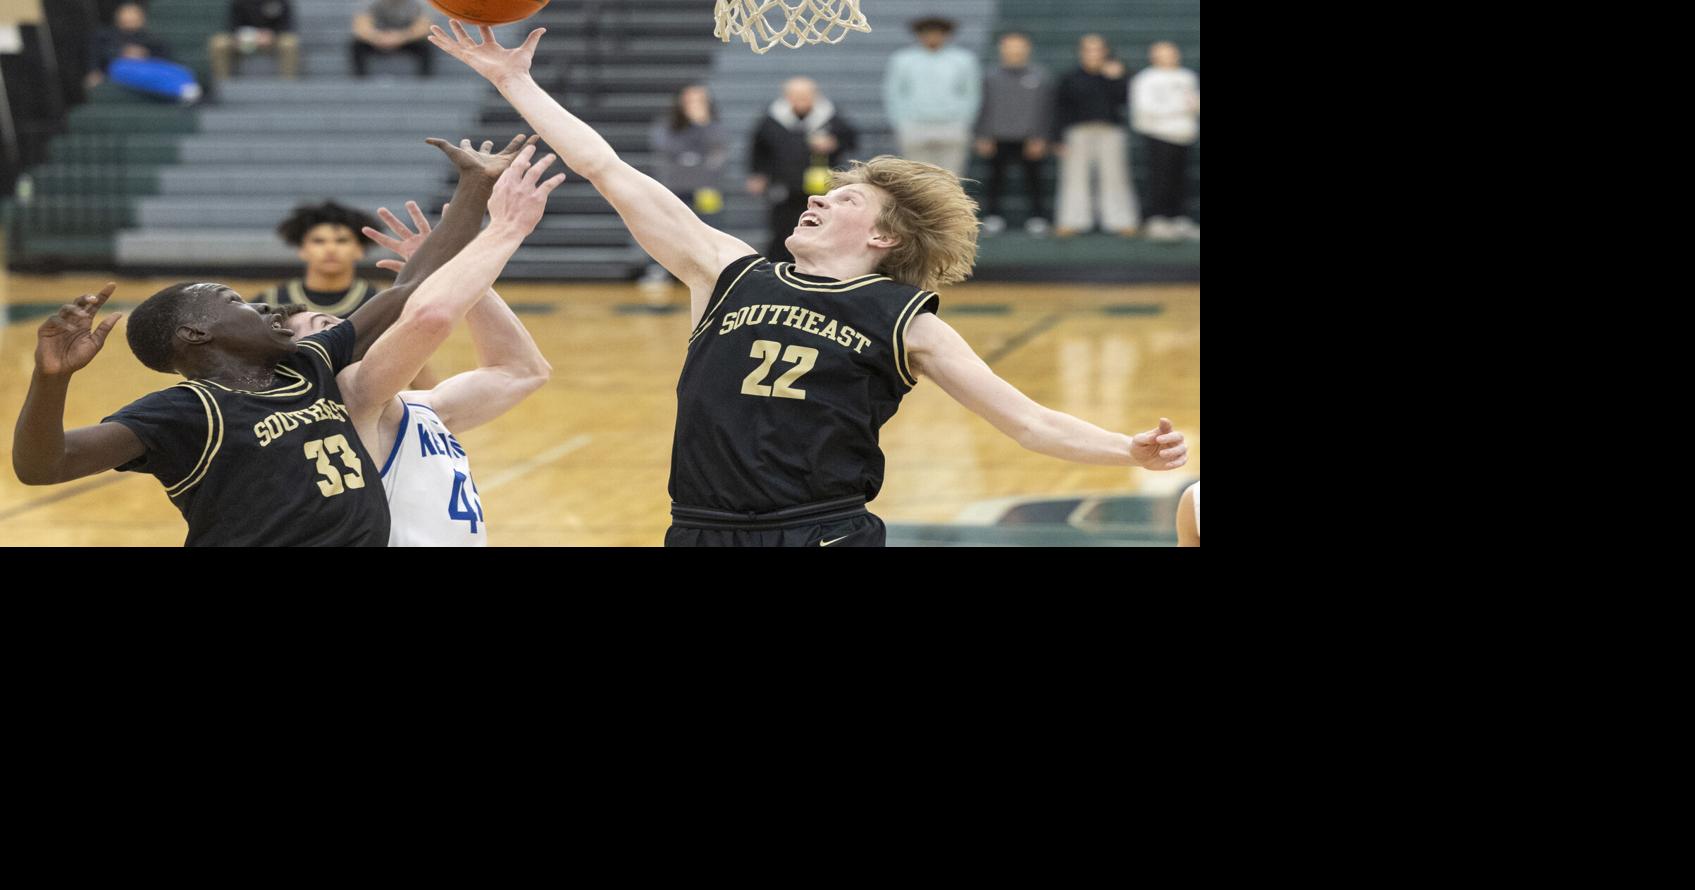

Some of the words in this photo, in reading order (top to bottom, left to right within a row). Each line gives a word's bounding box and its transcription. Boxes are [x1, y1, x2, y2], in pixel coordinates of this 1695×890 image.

[719, 304, 871, 354] SOUTHEAST
[740, 339, 819, 400] 22
[304, 434, 365, 497] 33
[448, 468, 484, 534] 4
